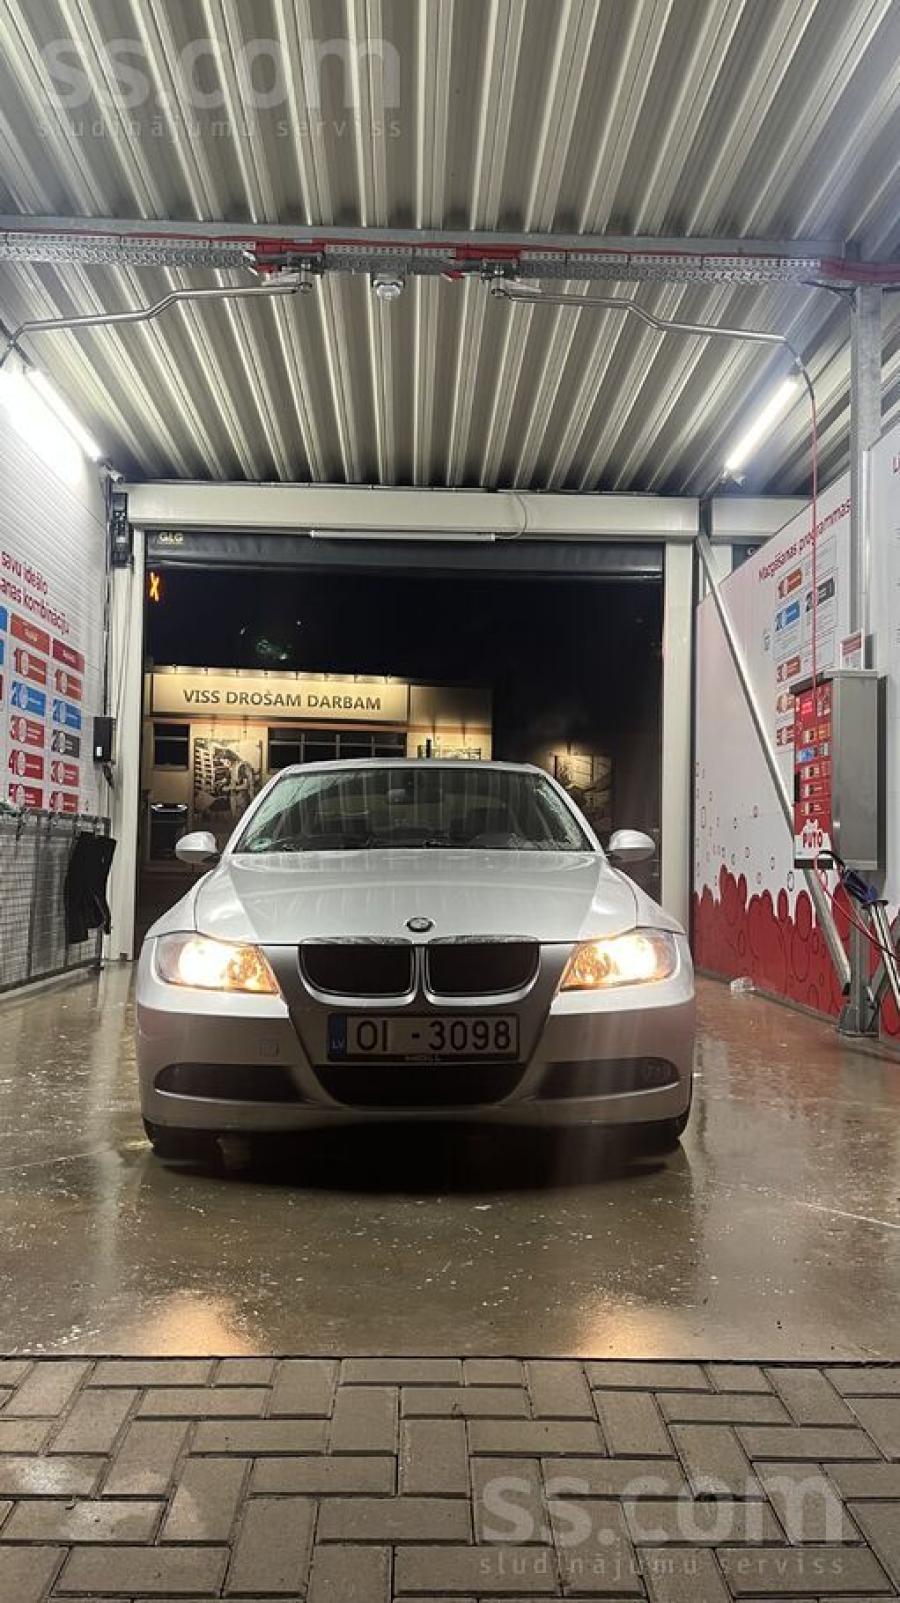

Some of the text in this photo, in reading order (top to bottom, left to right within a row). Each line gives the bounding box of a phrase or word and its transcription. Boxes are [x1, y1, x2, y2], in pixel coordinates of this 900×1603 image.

[183, 689, 381, 711] VISS DROŠAM DARBAM
